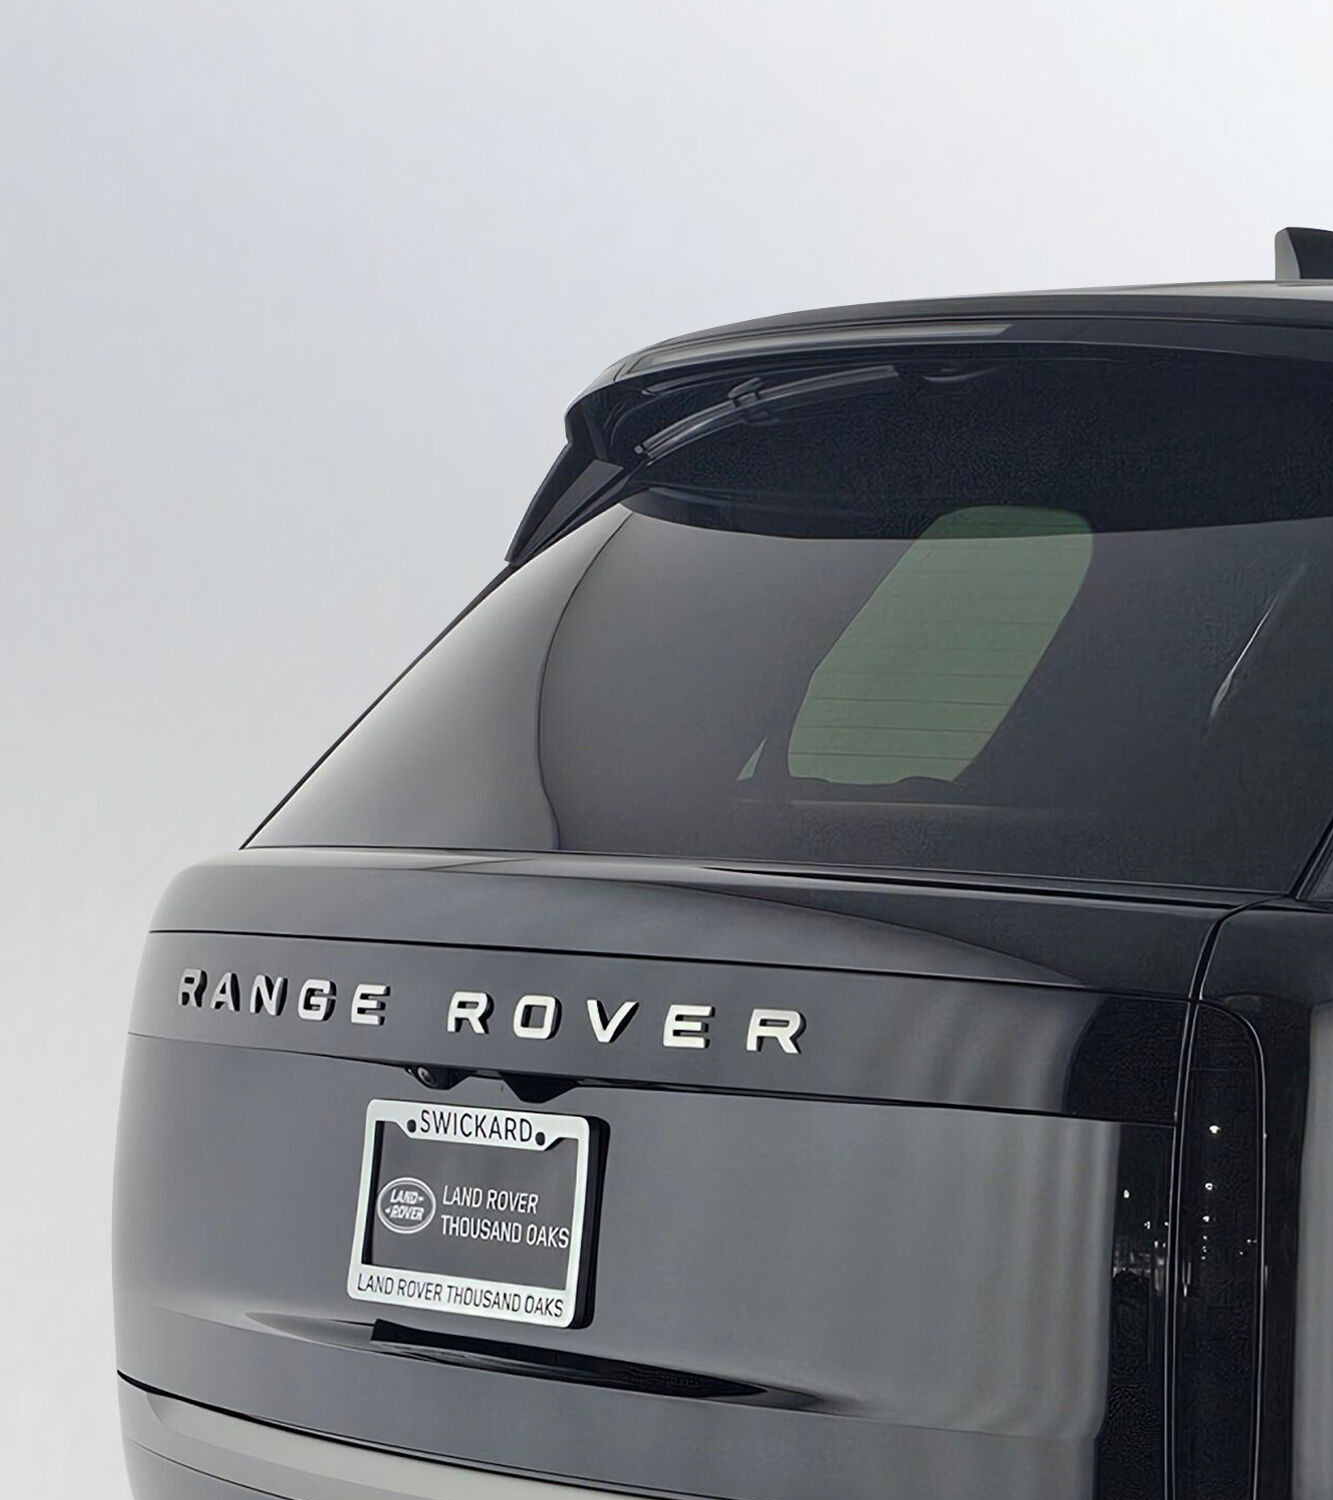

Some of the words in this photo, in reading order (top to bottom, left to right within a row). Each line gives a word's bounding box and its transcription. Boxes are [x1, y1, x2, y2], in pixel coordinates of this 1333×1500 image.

[177, 967, 392, 1027] RANGE
[446, 991, 808, 1055] ROVER
[419, 1108, 534, 1143] SWICKARD
[389, 1204, 425, 1221] ROVER
[443, 1184, 482, 1209] LAND
[486, 1188, 539, 1215] ROVER
[440, 1214, 523, 1244] THOUSAND
[526, 1223, 571, 1249] OAKS
[357, 1272, 394, 1297] LAND
[399, 1278, 443, 1303] ROVER
[446, 1284, 522, 1313] THOUSAND
[524, 1294, 564, 1319] OAKS
